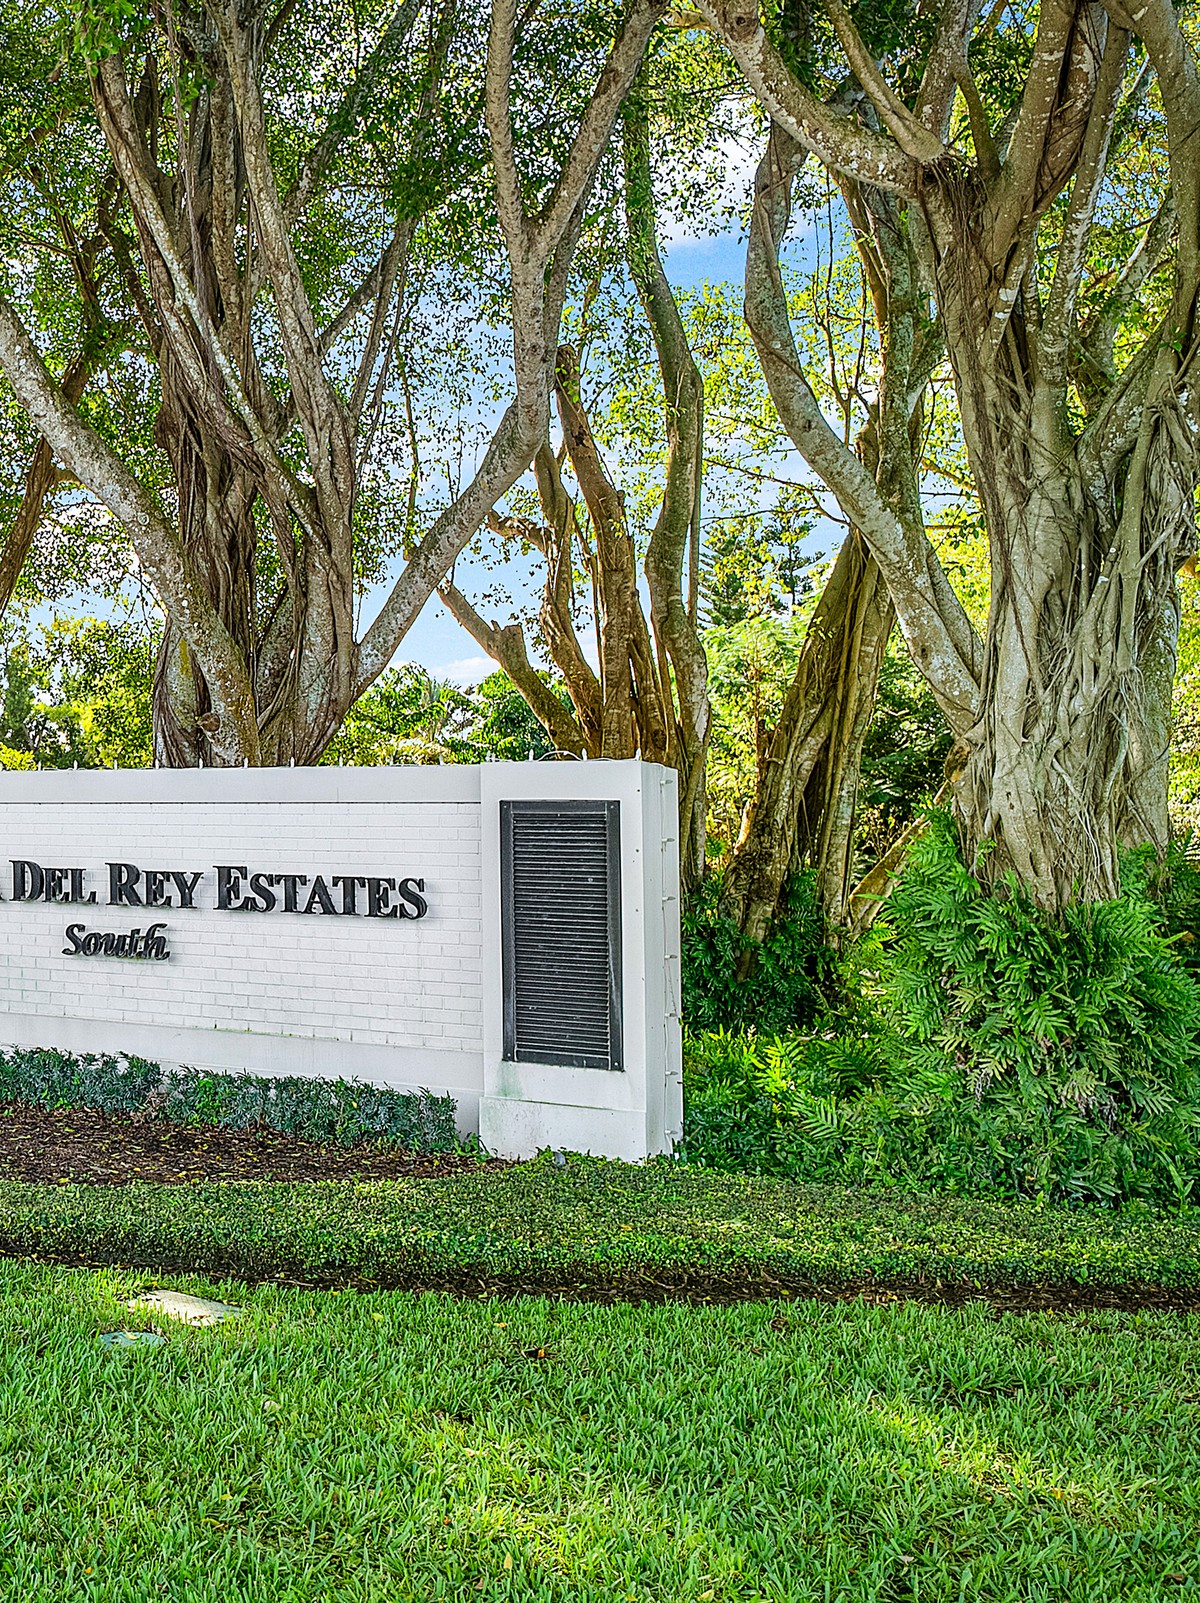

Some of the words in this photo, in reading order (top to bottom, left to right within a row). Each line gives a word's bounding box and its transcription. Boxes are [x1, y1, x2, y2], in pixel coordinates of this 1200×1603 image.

[8, 860, 98, 904] DEL
[105, 862, 204, 909] REY
[212, 865, 428, 920] ESTATES
[61, 922, 171, 961] South
